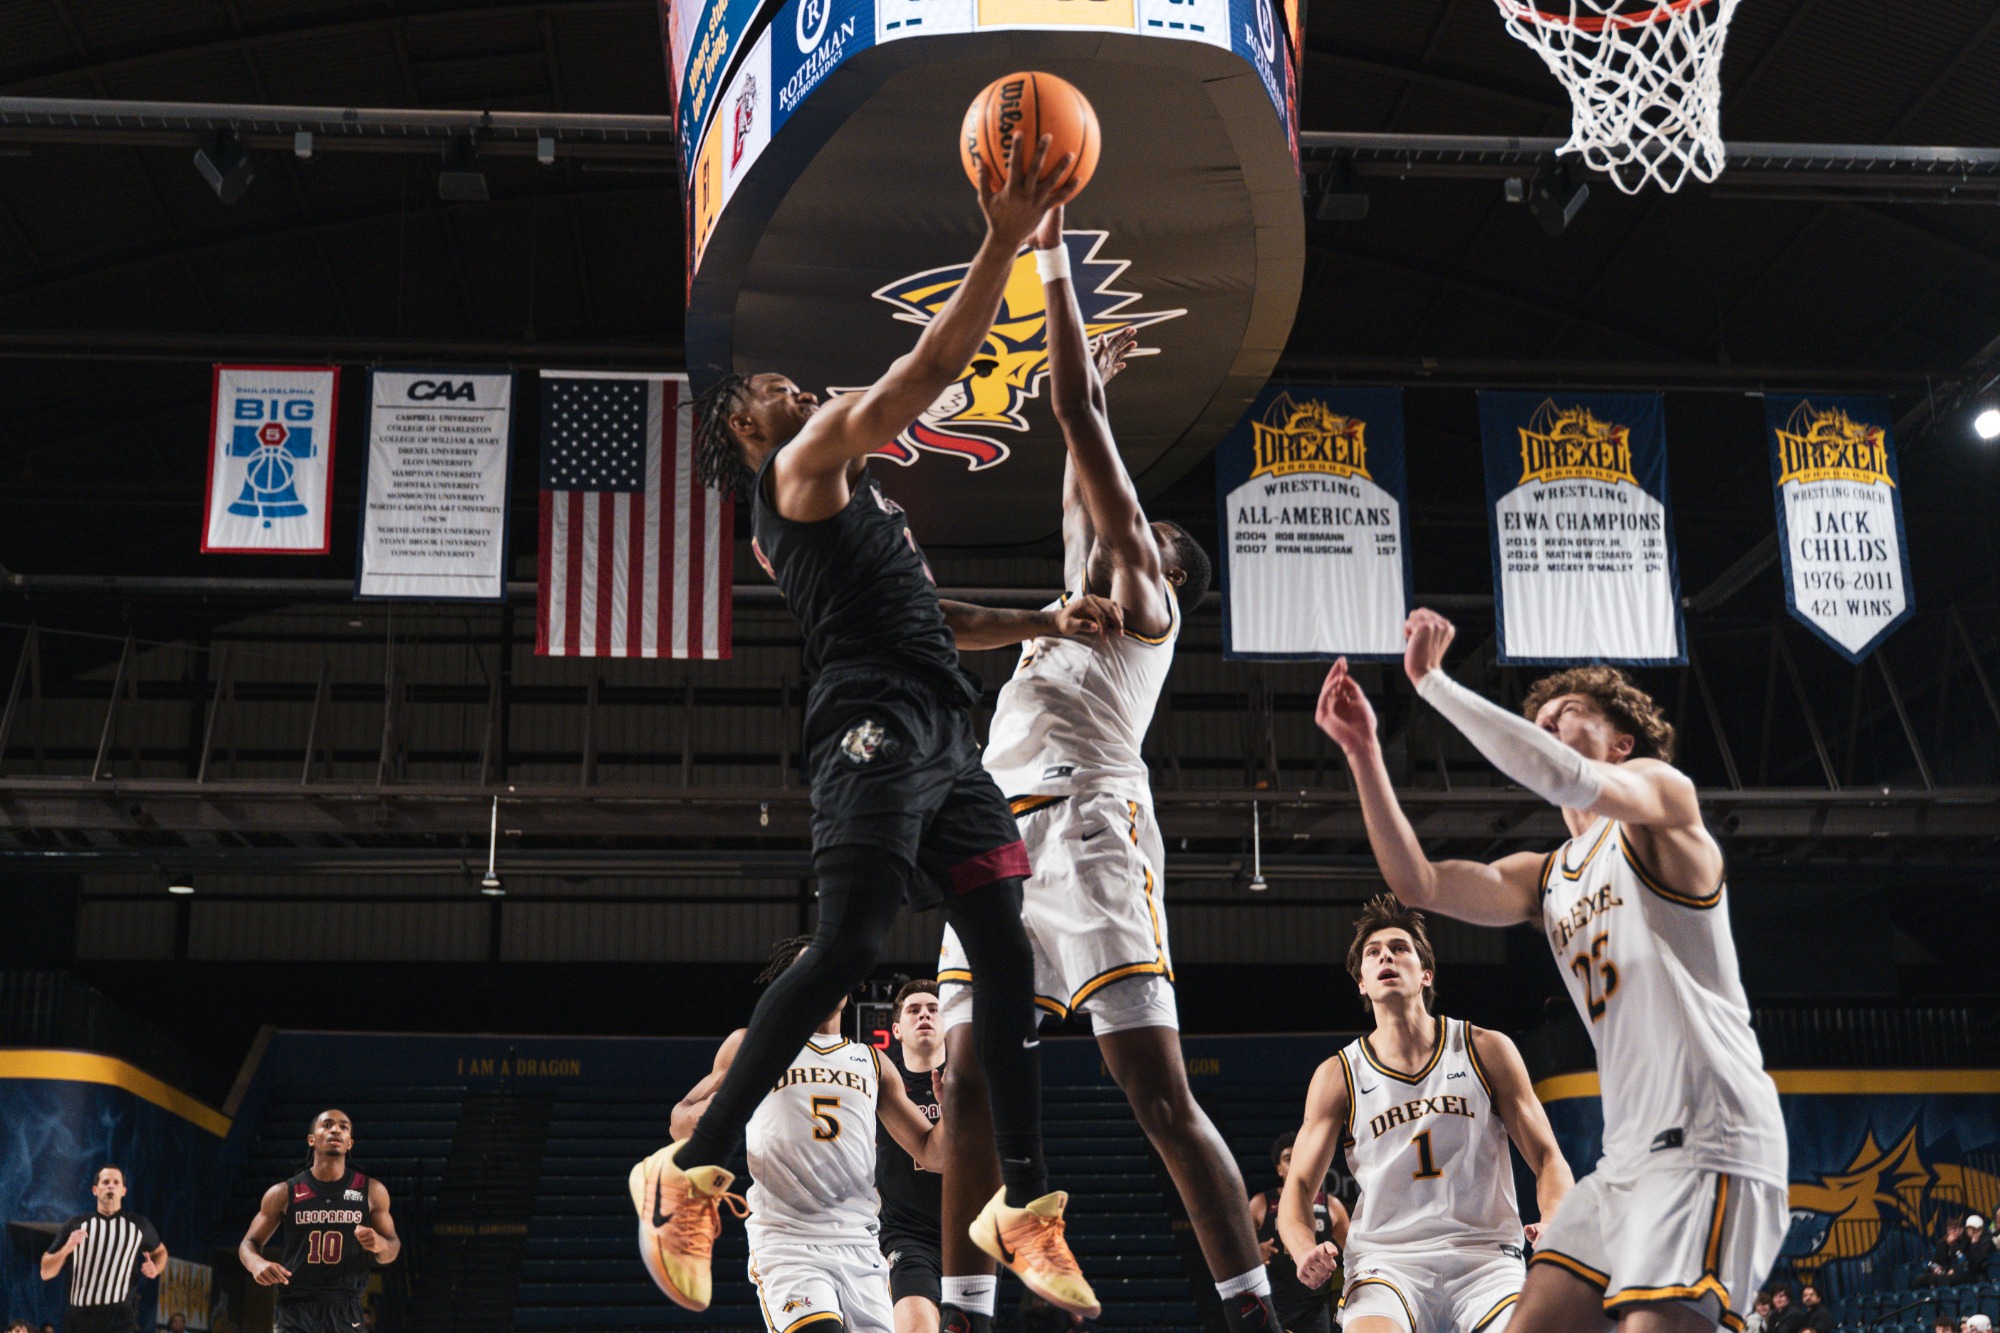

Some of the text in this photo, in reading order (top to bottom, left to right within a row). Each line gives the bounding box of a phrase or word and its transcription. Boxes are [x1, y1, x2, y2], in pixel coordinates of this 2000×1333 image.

[779, 15, 856, 111] ROTHMAN
[787, 47, 843, 112] ORTHOPAEDICS
[235, 387, 315, 395] PHILADELPHIA
[407, 380, 476, 402] CAA
[234, 397, 314, 421] BIG
[395, 414, 485, 423] CAMPBELL UNIVERSITY
[265, 428, 280, 441] 5
[387, 424, 424, 432] COLLEGE
[439, 425, 492, 433] CHARLESTON
[379, 435, 416, 443] COLLEGE
[431, 436, 466, 444] WILLIAM
[476, 437, 500, 446] MARY
[1260, 426, 1362, 470] DREXEL
[398, 446, 478, 456] DREXEL UNIVERSITY
[1526, 435, 1628, 476] DREXEL
[1784, 438, 1884, 476] DREXEL
[426, 458, 473, 467] UNIVERSITY
[392, 469, 482, 479] HAMPTON UNIVERSITY
[433, 481, 480, 490] UNIVERSITY
[1264, 479, 1361, 499] WRESTLING
[438, 493, 485, 501] UNIVERSITY
[1533, 485, 1628, 503] WRESTLING
[1792, 487, 1886, 504] WRESTLING COACH
[398, 503, 437, 511] CAROLINA
[457, 505, 501, 514] UNIVERSITY
[1237, 506, 1391, 526] ALL-AMERICANS
[1504, 512, 1661, 532] EIWA CHAMPIONS
[1811, 510, 1871, 534] JACK
[377, 525, 491, 536] NORTHEASTERN UNIVERSITY
[1235, 531, 1267, 541] 2004
[1275, 532, 1294, 542] ROB
[1375, 533, 1396, 543] 125
[440, 538, 487, 547] UNIVERSITY
[1235, 544, 1267, 554] 2007
[1275, 545, 1300, 554] RYAN
[1377, 546, 1397, 555] 157
[1506, 537, 1537, 547] 2015
[1544, 537, 1574, 547] KEVIN
[1801, 537, 1888, 562] CHILDS
[428, 550, 475, 558] UNIVERSITY
[1507, 550, 1538, 560] 2016
[1545, 550, 1593, 560] MATTHEW
[1508, 563, 1540, 572] 2022
[1547, 563, 1584, 572] MICKEY
[1803, 571, 1893, 591] 1976-2011
[1811, 600, 1892, 616] 421 WINS
[469, 1057, 495, 1076] AM
[500, 1058, 511, 1076] A
[516, 1058, 580, 1077] DRAGON
[849, 1055, 867, 1063] CAA
[774, 1067, 872, 1100] DREXEL
[1446, 1071, 1467, 1080] CAA
[811, 1094, 841, 1142] 5
[1369, 1095, 1476, 1140] DREXEL
[1410, 1127, 1444, 1181] 1
[296, 1209, 363, 1225] LEOPARDS
[307, 1230, 343, 1265] 10
